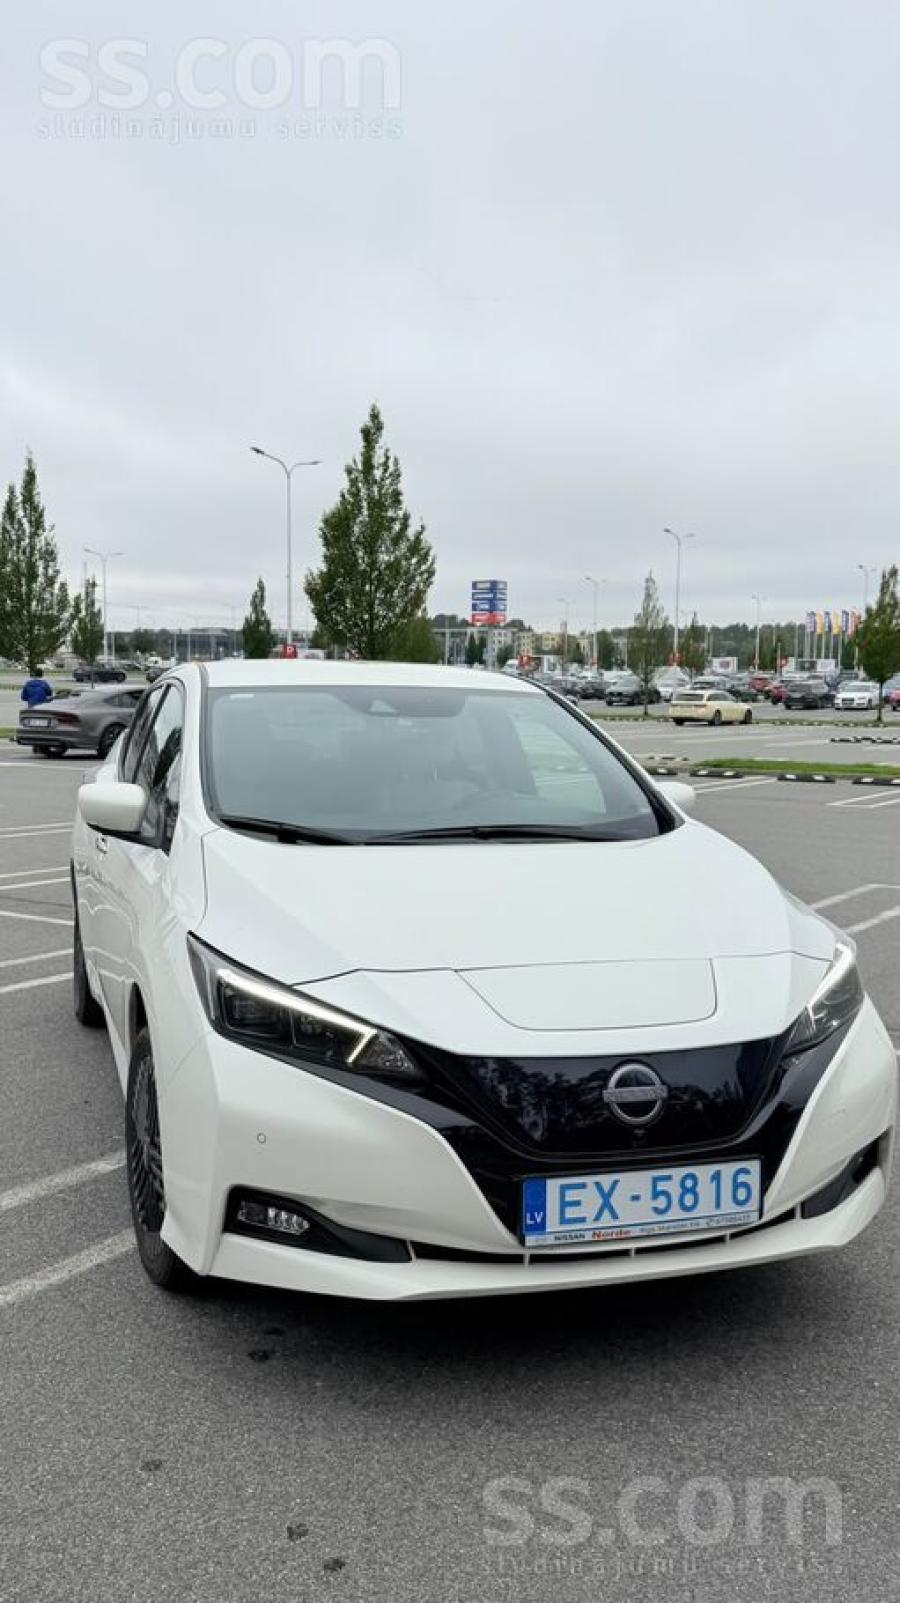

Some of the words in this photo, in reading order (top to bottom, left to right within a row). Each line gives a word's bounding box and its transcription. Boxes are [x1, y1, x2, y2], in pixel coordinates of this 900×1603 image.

[603, 1086, 667, 1103] NAN
[559, 1167, 753, 1226] EX-5816
[526, 1211, 543, 1225] LV
